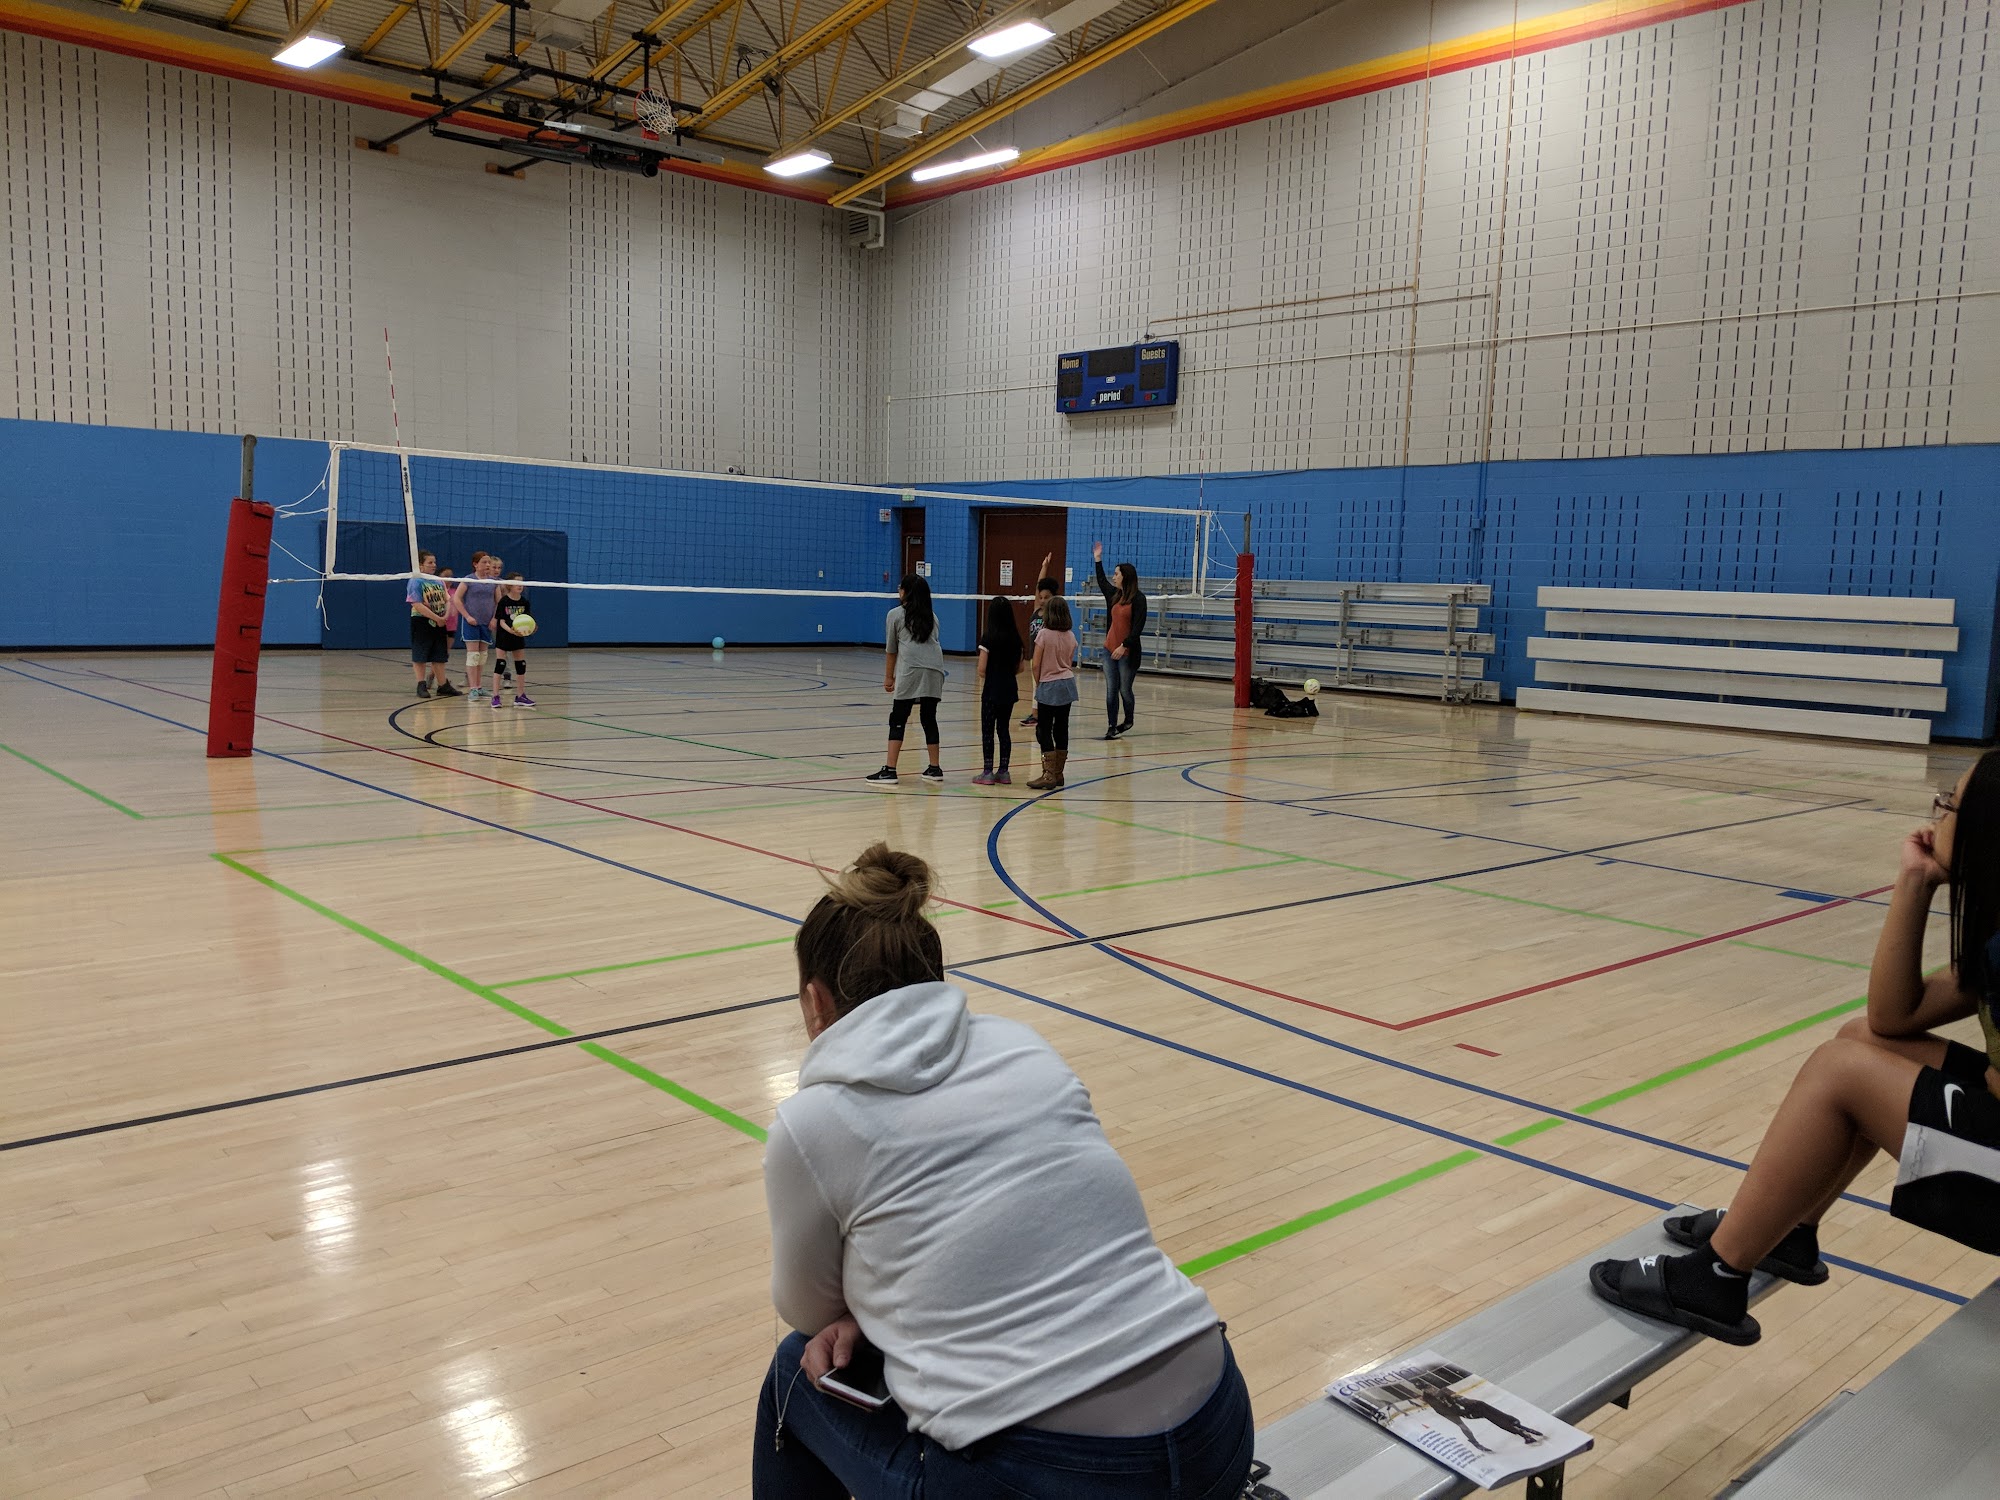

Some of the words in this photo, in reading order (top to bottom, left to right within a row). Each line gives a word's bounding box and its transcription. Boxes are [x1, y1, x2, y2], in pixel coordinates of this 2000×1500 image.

[1141, 348, 1166, 360] Guests
[1061, 358, 1080, 370] Home
[1099, 390, 1121, 404] period
